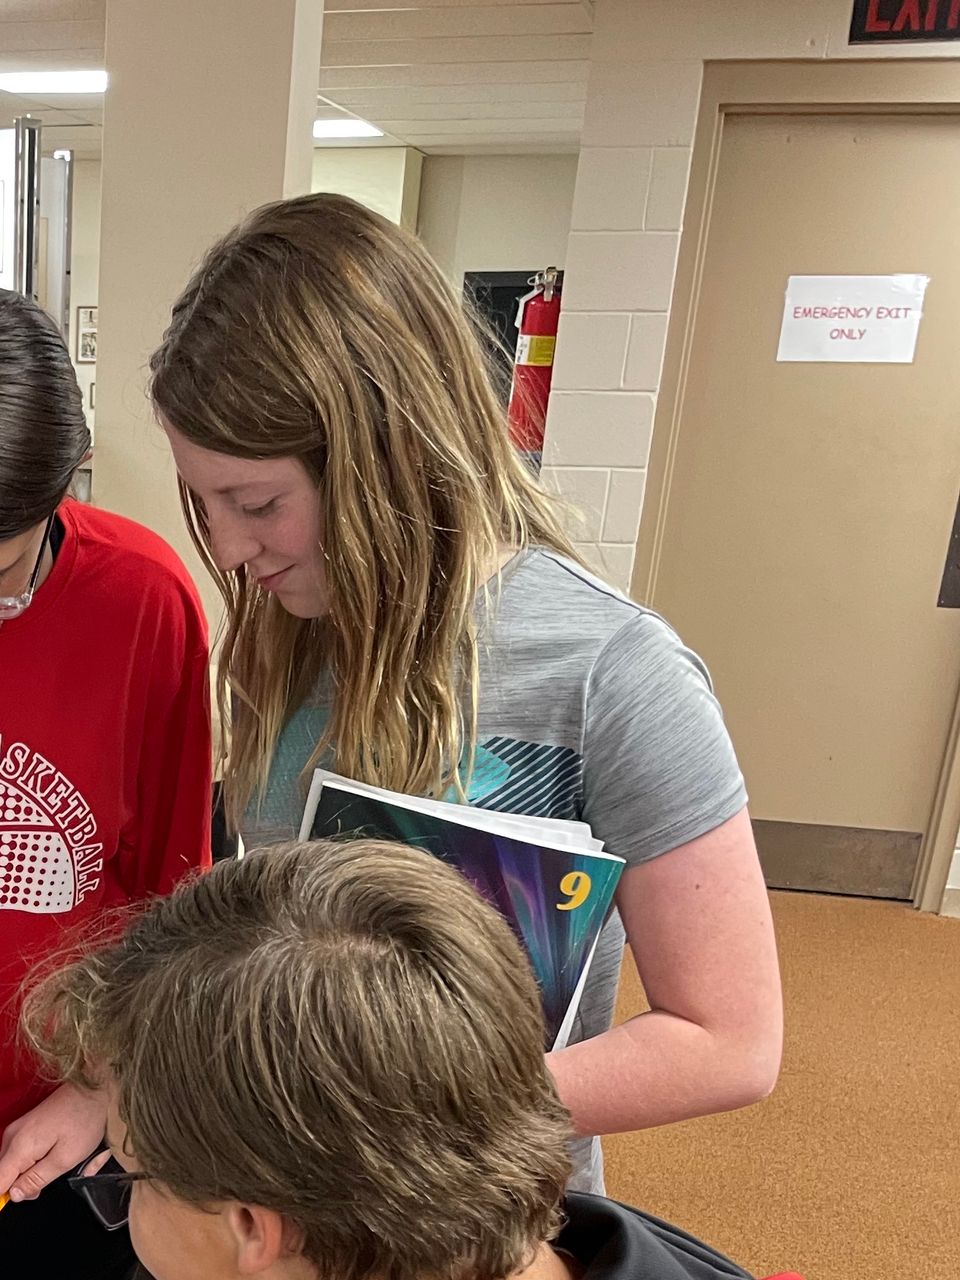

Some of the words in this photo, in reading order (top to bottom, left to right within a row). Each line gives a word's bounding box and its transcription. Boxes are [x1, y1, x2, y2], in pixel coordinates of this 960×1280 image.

[793, 306, 872, 319] EMERGENCY
[876, 307, 912, 319] EXIT
[829, 328, 867, 340] ONLY
[555, 870, 593, 912] 9
